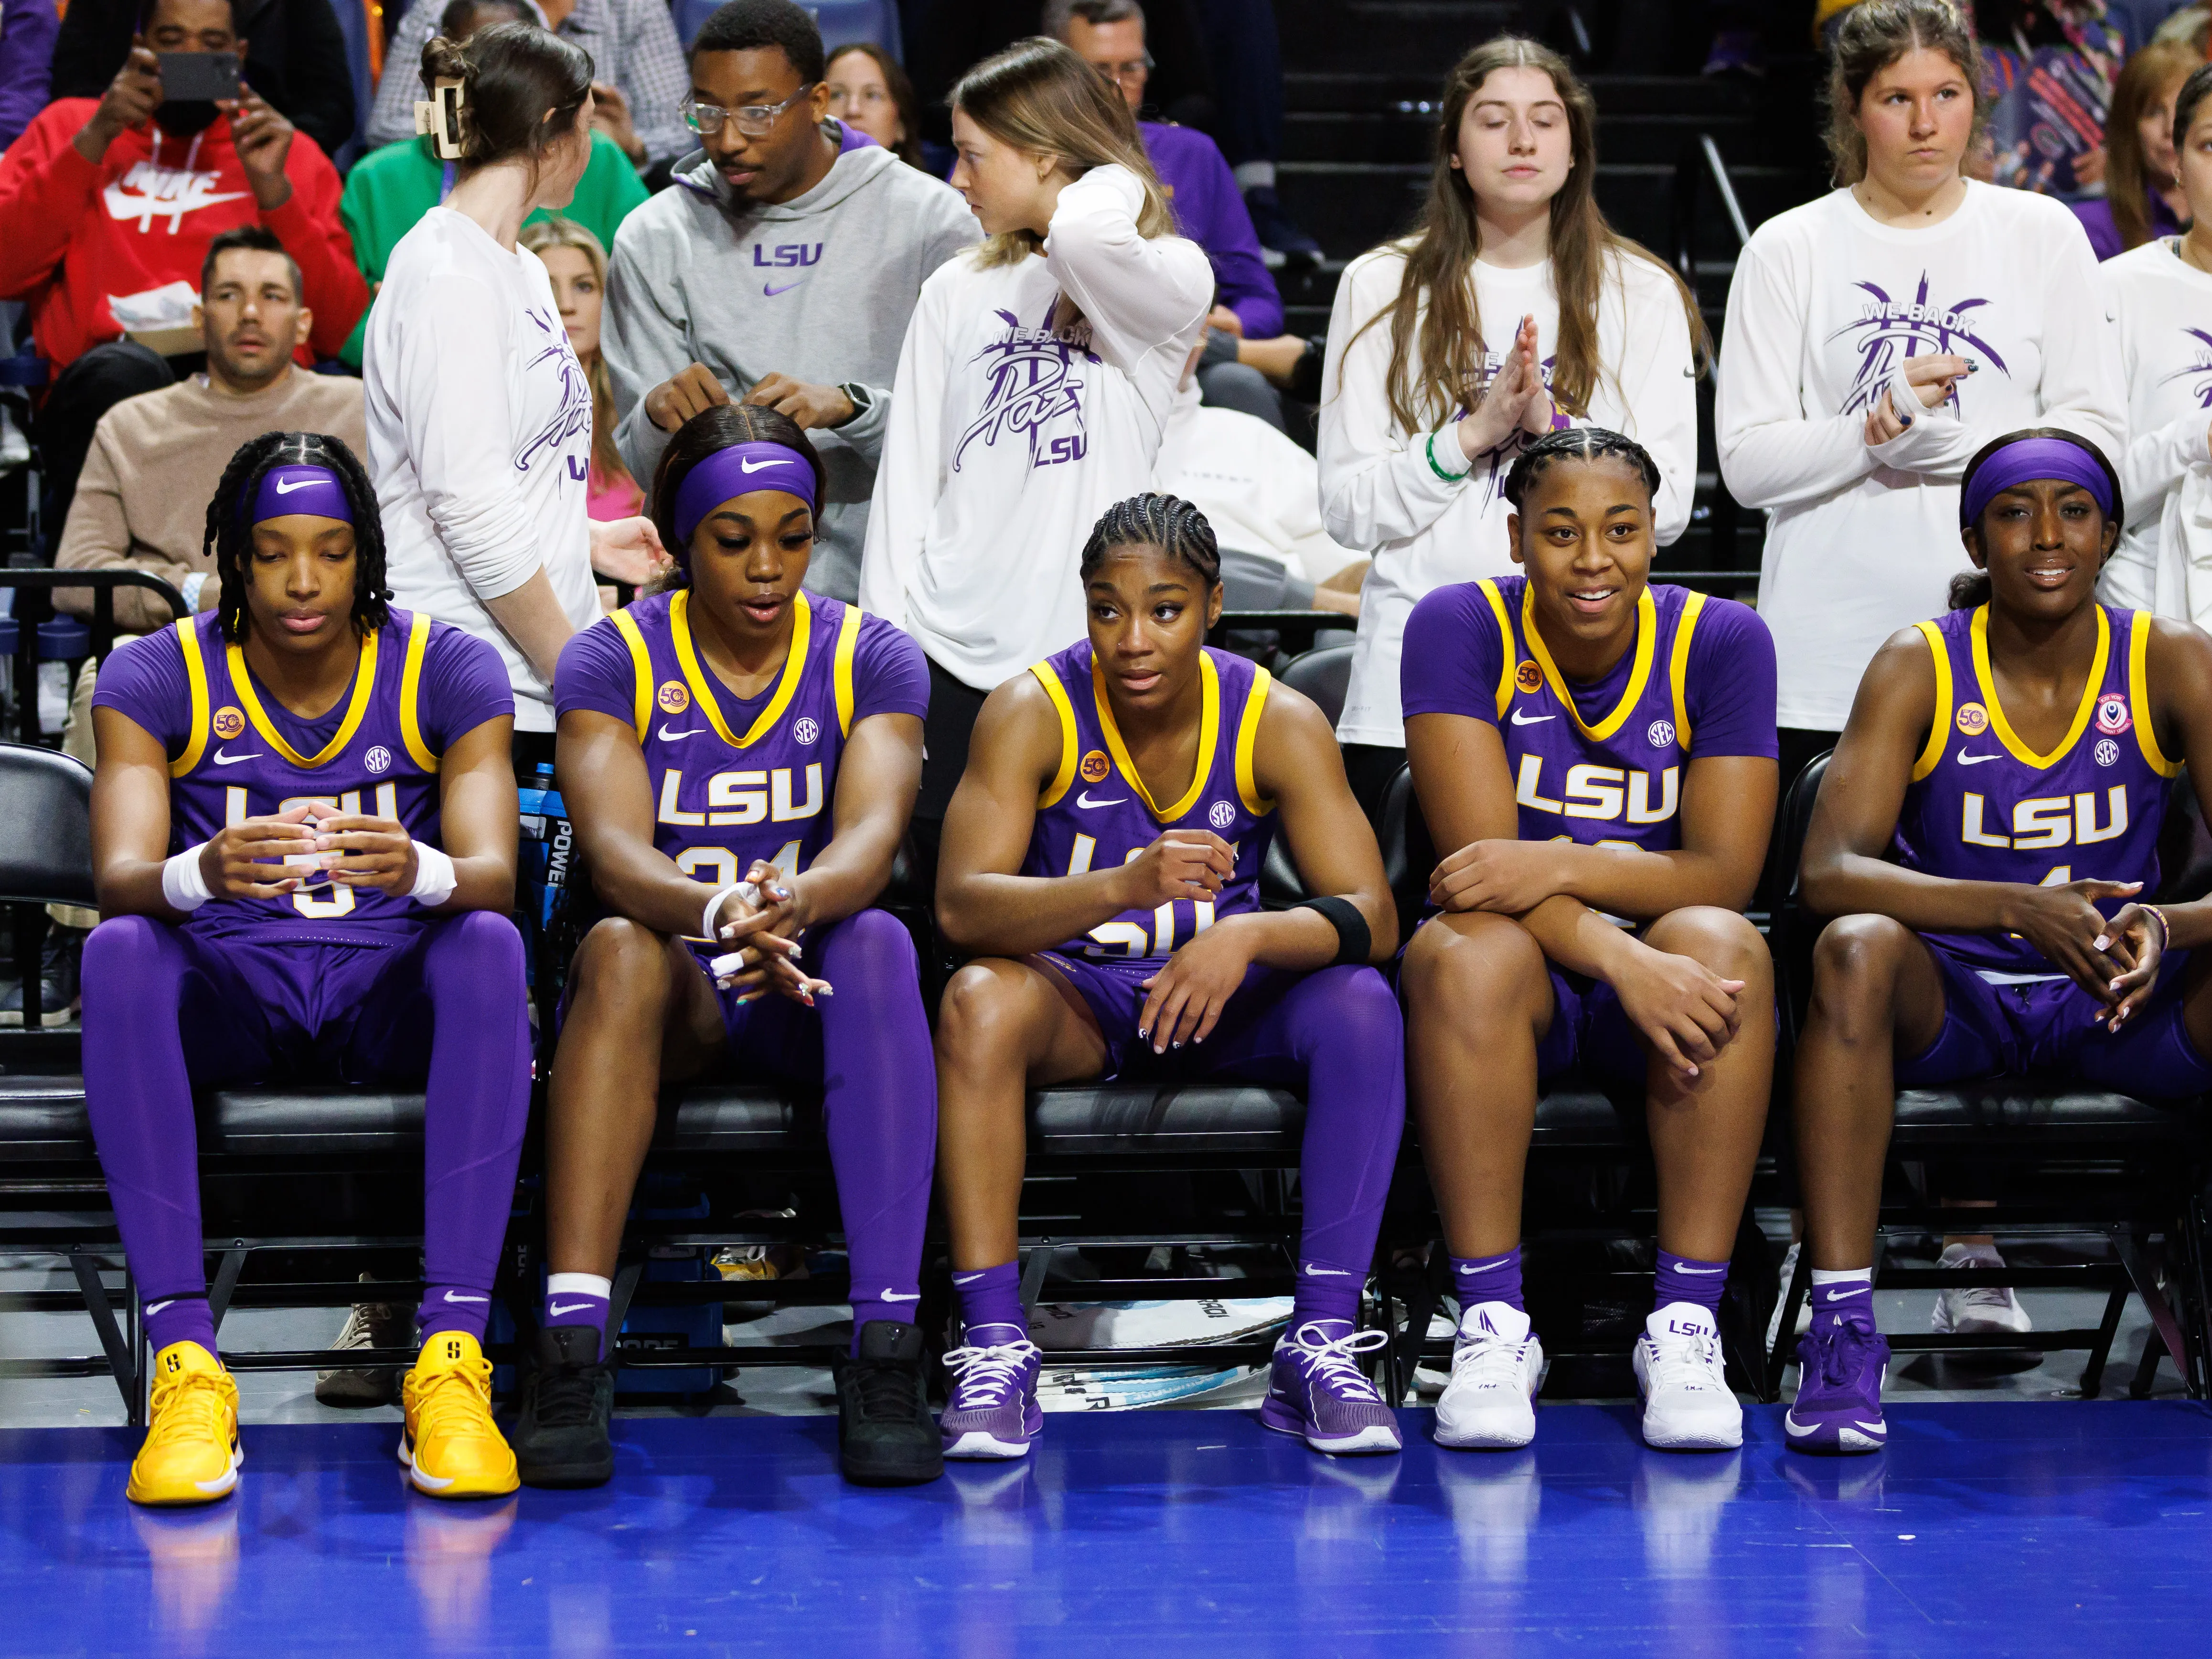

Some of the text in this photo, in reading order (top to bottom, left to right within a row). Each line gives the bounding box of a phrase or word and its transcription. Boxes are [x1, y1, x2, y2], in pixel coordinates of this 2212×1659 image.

[754, 242, 823, 267] LSU
[1863, 302, 1976, 337] WE BACK
[993, 326, 1028, 345] WE
[1033, 431, 1087, 469] LSU
[660, 687, 684, 704] 50
[216, 714, 240, 731] 50
[1959, 709, 1983, 726] 50
[795, 719, 817, 743] SEC
[1650, 721, 1673, 746] SEC
[367, 748, 389, 771] SEC
[2097, 741, 2116, 764] SEC
[658, 762, 823, 826] LSU
[1516, 753, 1678, 824] LSU
[1210, 803, 1234, 826] SEC
[1962, 784, 2128, 850] LSU
[548, 820, 573, 888] POWE
